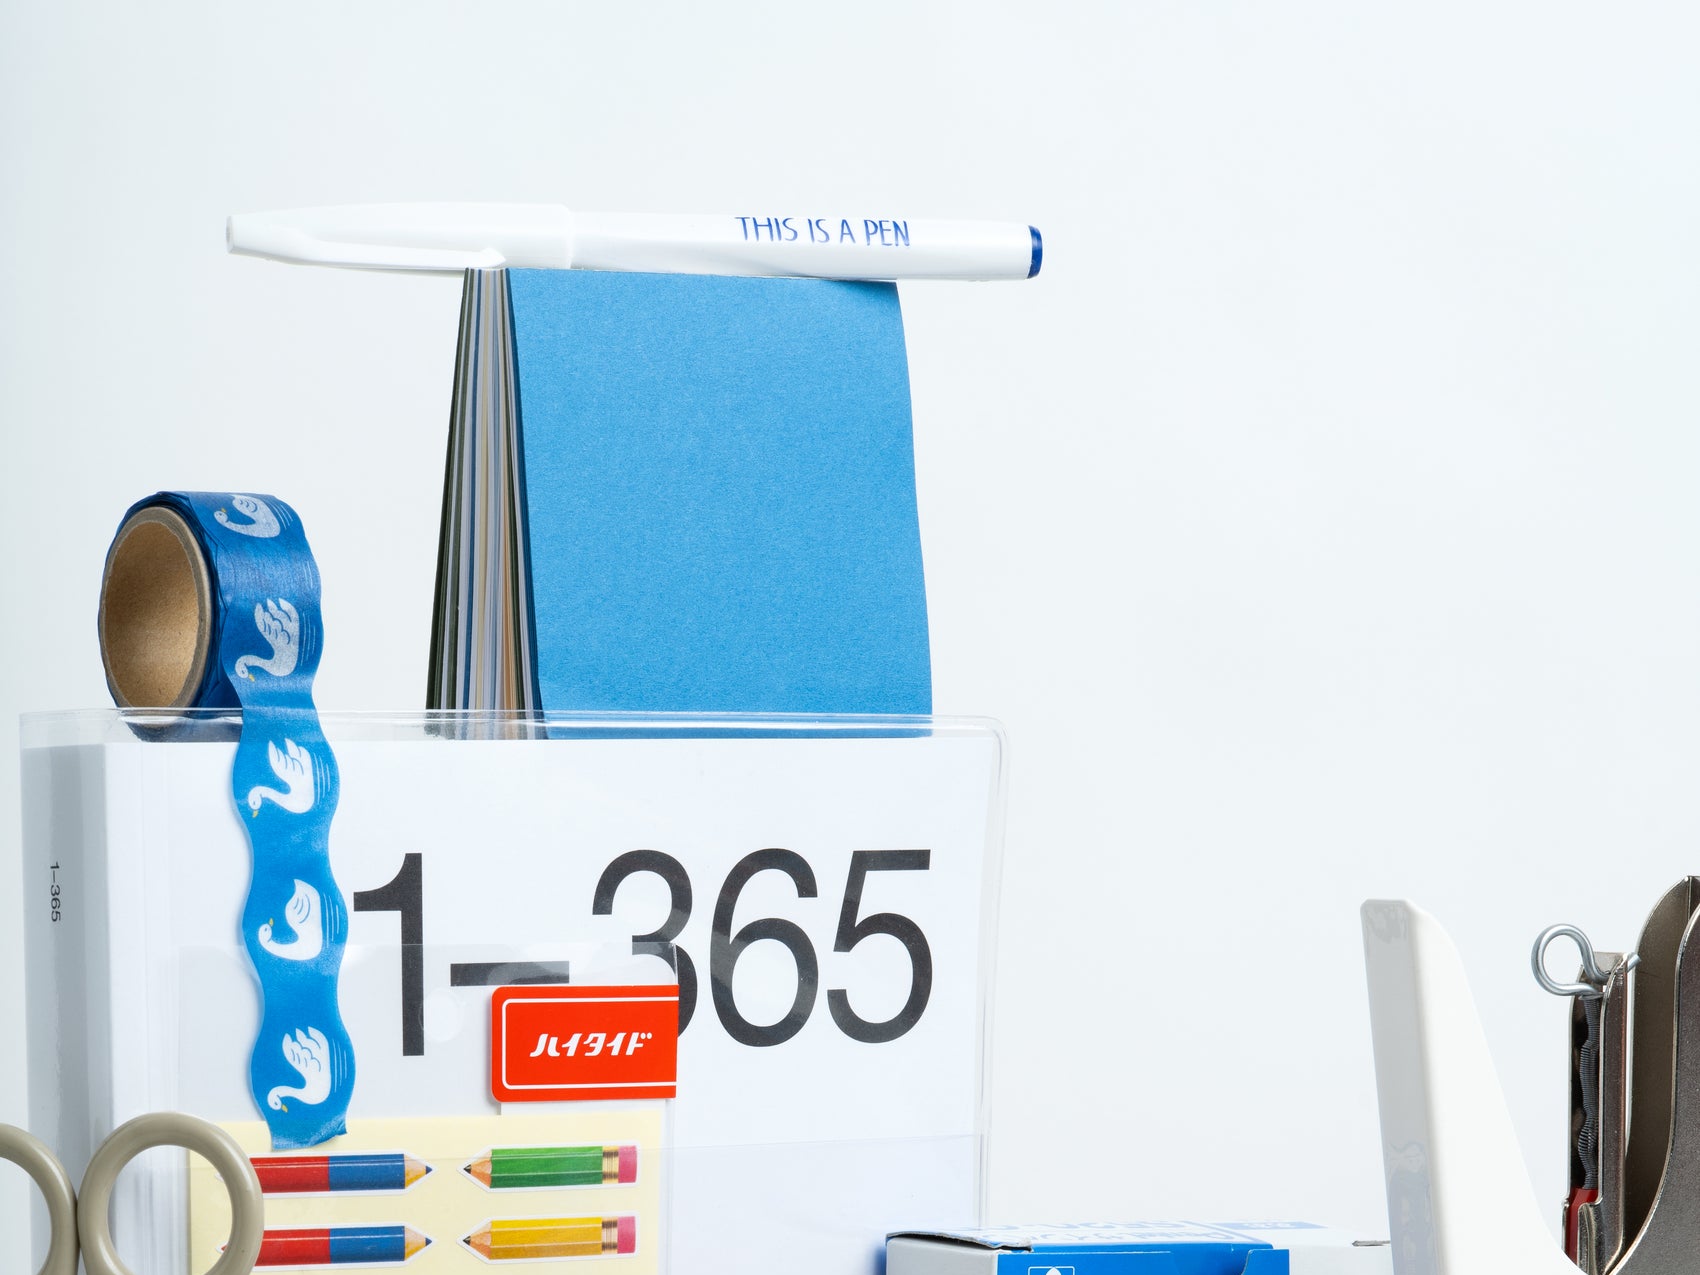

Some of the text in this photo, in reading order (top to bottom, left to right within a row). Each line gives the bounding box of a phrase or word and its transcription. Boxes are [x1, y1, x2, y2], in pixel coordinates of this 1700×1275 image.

[735, 216, 911, 247] THIS IS A PEN
[529, 1032, 653, 1058] ハイタイド
